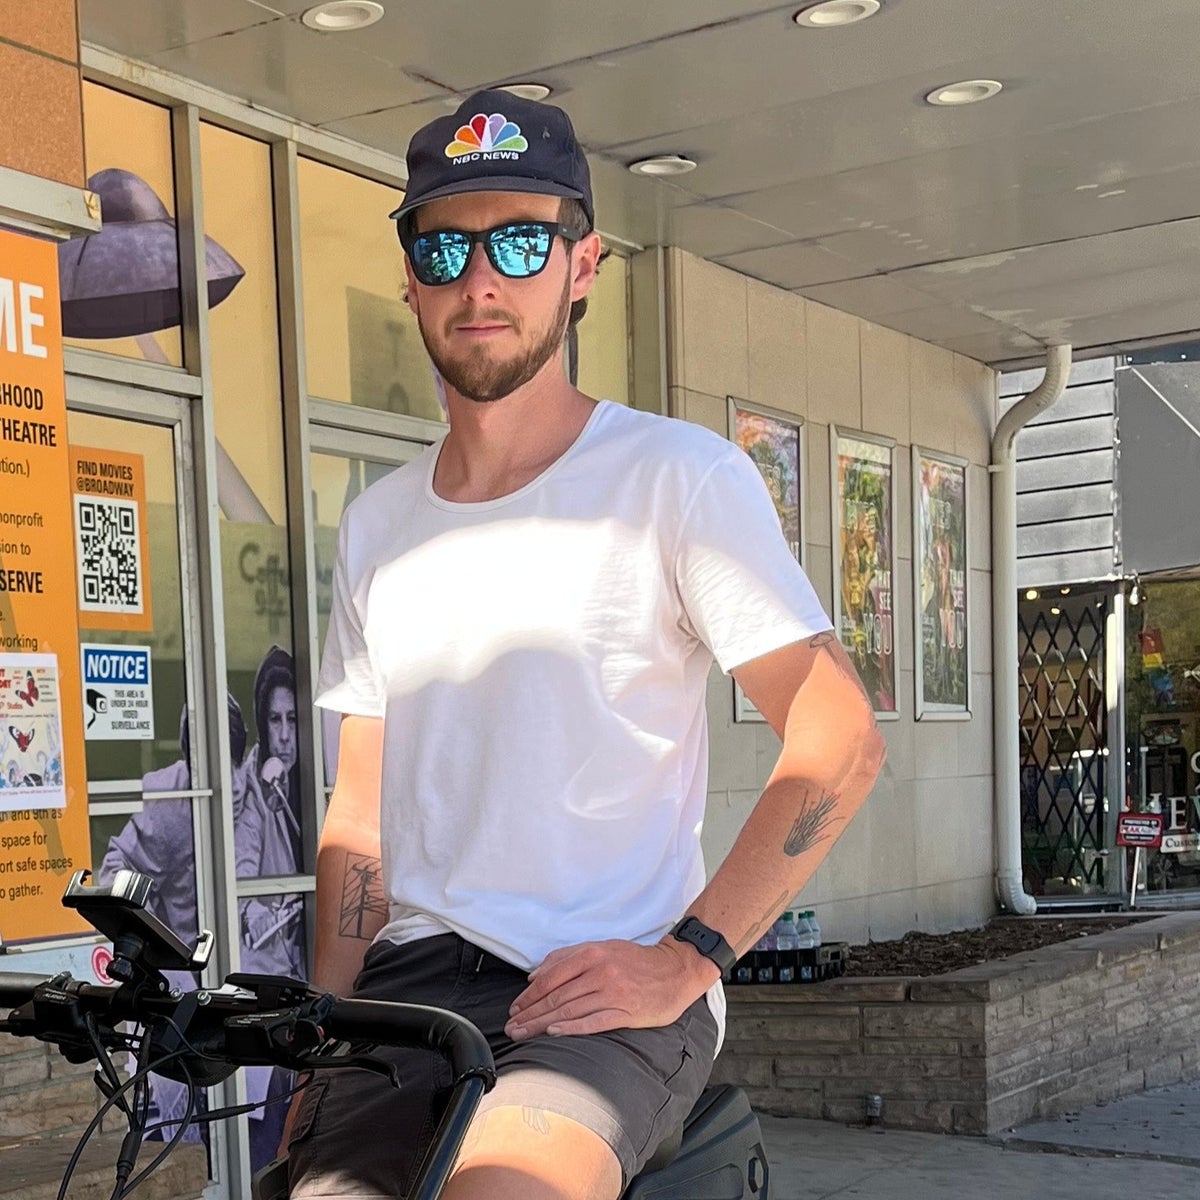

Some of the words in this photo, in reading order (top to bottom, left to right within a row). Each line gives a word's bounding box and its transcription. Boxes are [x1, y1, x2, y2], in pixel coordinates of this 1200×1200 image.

[453, 153, 480, 165] NBC
[483, 152, 519, 160] NEWS
[77, 460, 97, 476] FIND
[99, 463, 133, 480] MOVIES
[77, 477, 134, 497] @BROADWAY
[20, 542, 31, 555] to
[87, 654, 146, 679] NOTICE
[11, 809, 30, 821] and
[51, 808, 63, 819] as
[1, 835, 30, 849] space
[33, 831, 48, 845] for
[16, 857, 36, 872] safe
[40, 858, 73, 872] spaces
[8, 883, 43, 901] gather.
